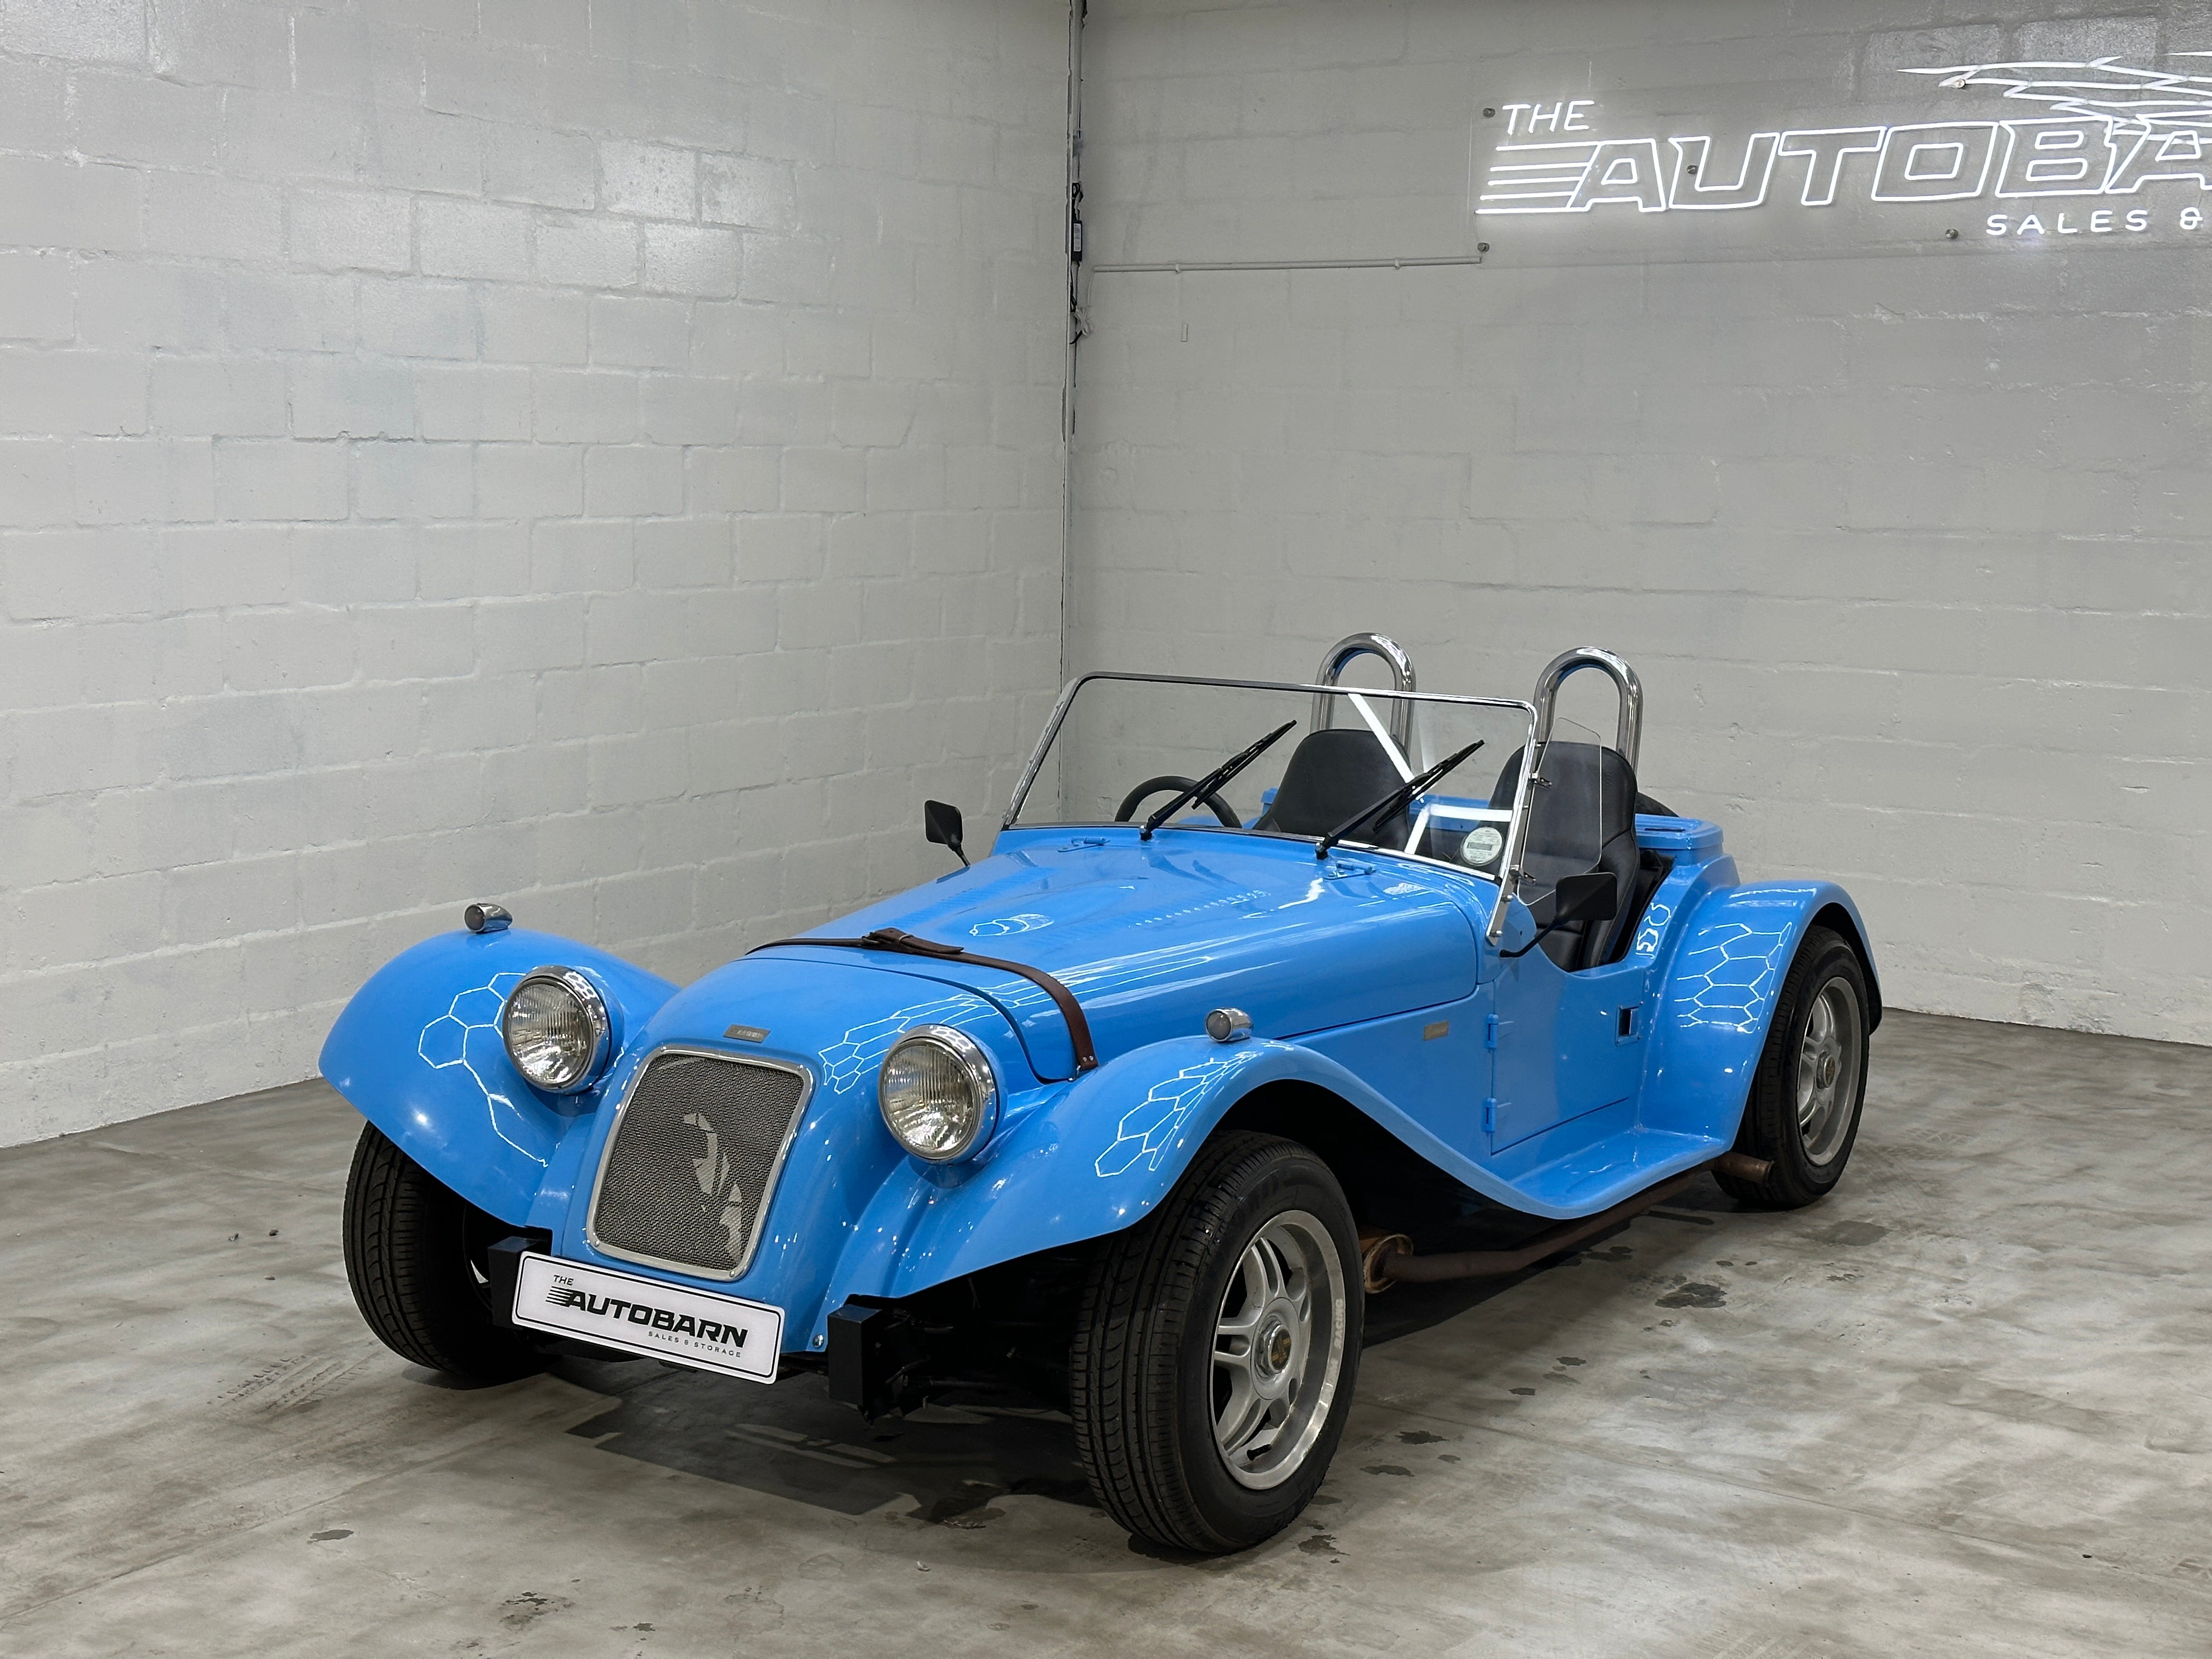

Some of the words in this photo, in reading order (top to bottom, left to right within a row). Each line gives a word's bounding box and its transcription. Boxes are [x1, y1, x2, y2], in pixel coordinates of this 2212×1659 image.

[1502, 100, 1595, 136] THE
[1566, 110, 2212, 213] AUTOBA
[1986, 210, 2148, 236] SALES
[2179, 207, 2203, 230] &
[554, 1274, 574, 1286] THE
[565, 1289, 748, 1348] AUTOBARN
[1334, 1297, 1344, 1350] RACING
[648, 1331, 679, 1343] SALES
[694, 1342, 741, 1358] STORAGE
